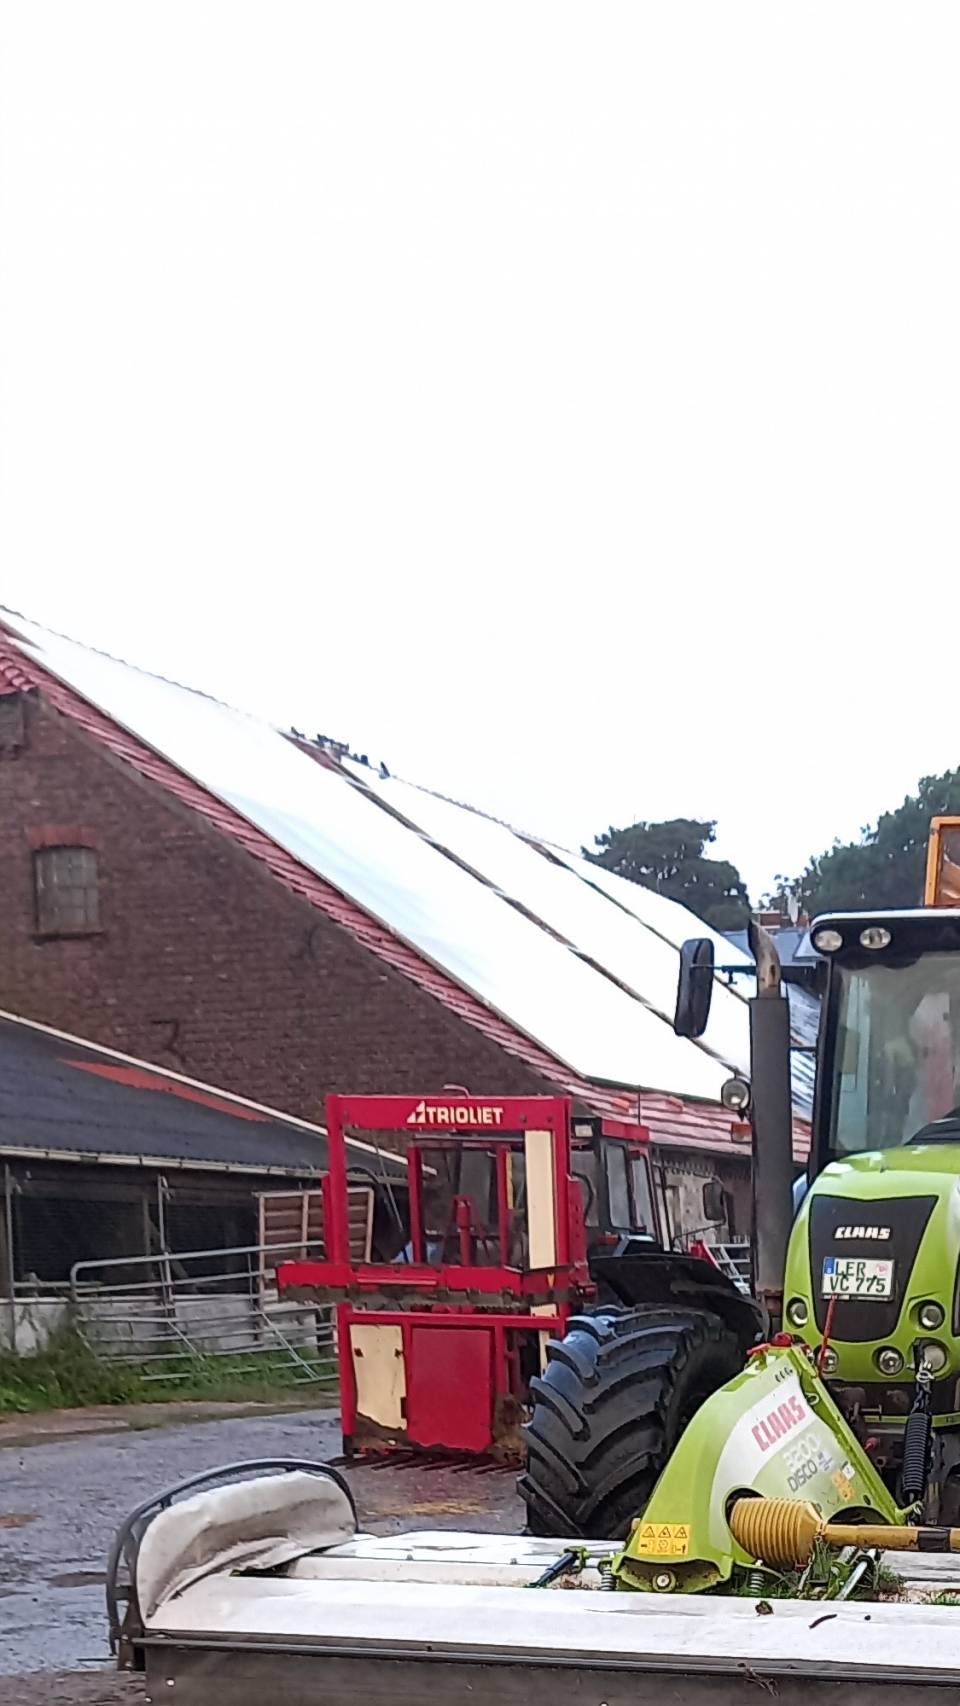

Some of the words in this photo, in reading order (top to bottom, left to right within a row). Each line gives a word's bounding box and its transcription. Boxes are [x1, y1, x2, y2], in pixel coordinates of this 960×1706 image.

[426, 1106, 504, 1124] TRIOLIET
[834, 1226, 891, 1240] CLAAS
[835, 1260, 866, 1278] LER
[830, 1276, 849, 1292] VC
[855, 1277, 886, 1293] 775
[751, 1395, 806, 1452] CLAAS
[786, 1459, 818, 1493] DISCO
